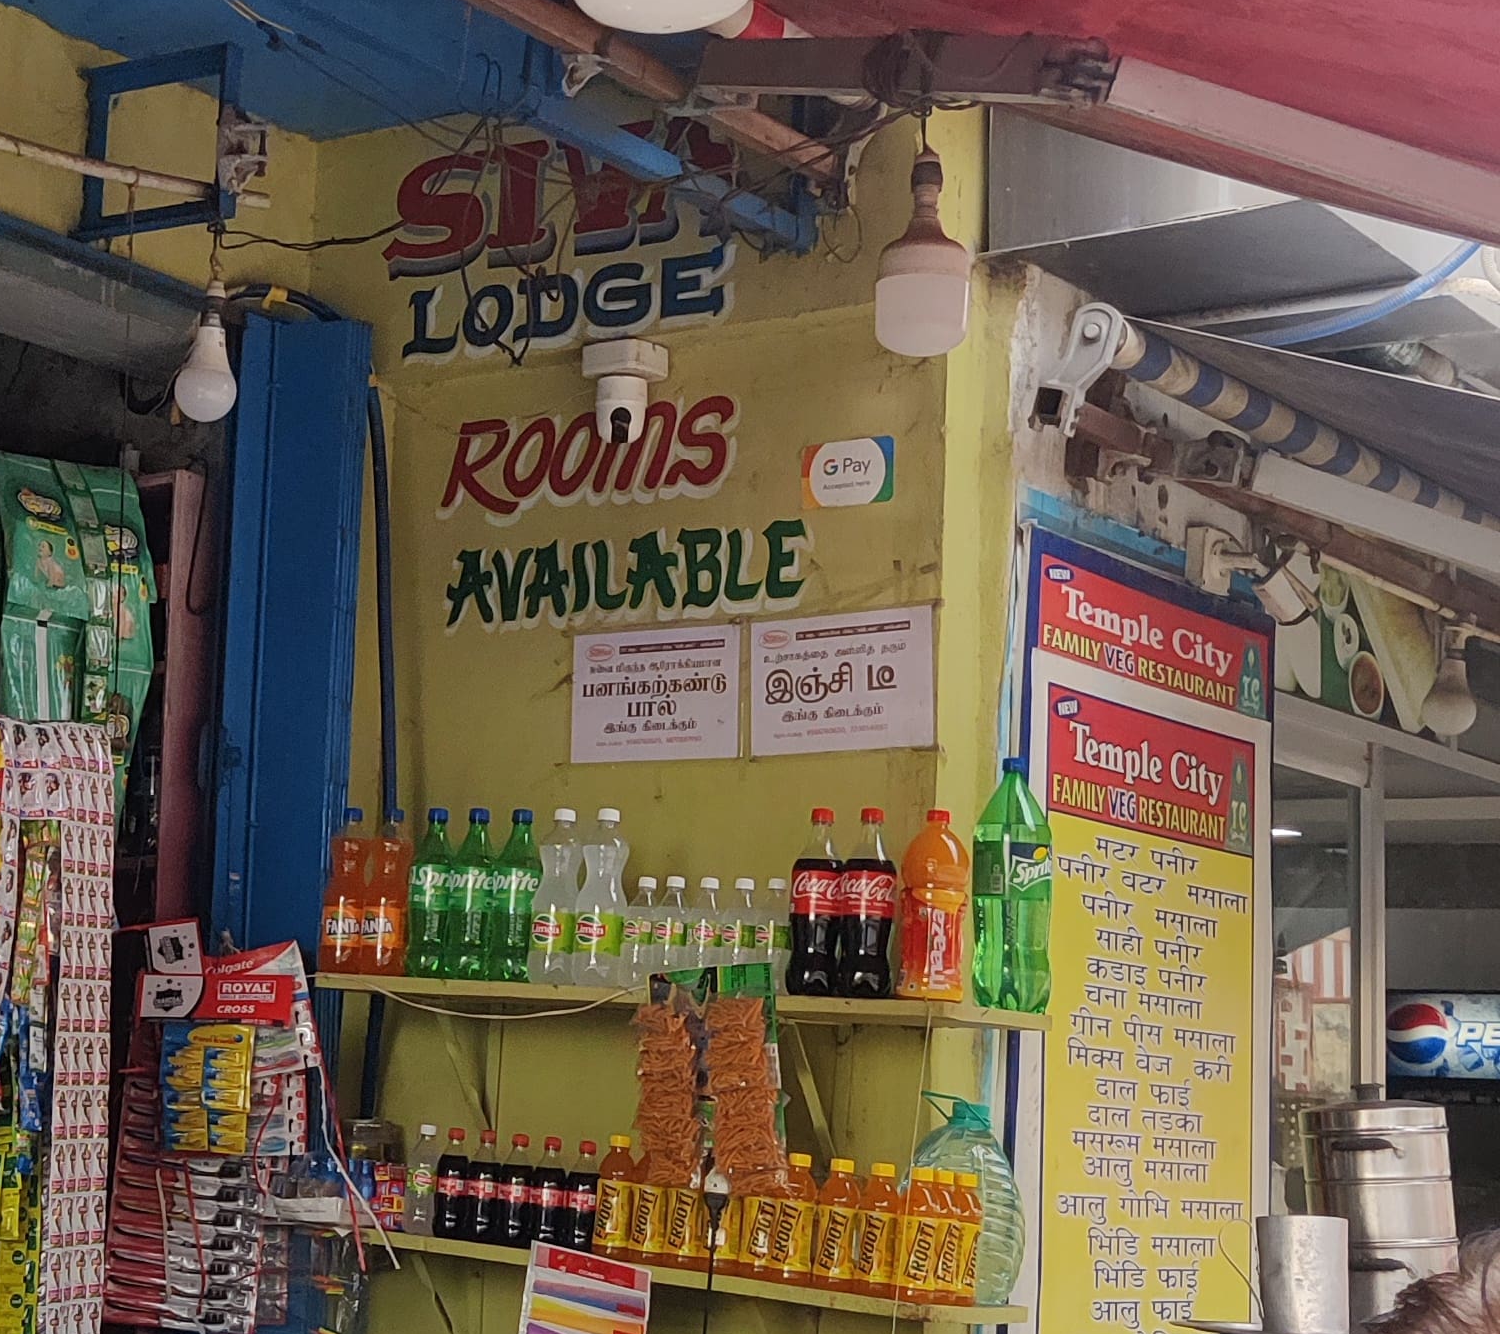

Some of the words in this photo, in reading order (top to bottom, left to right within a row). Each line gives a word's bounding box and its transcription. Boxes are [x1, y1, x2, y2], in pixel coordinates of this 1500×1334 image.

[402, 248, 730, 360] LODGE
[440, 395, 737, 517] ROOMS
[842, 457, 871, 476] Pay
[445, 519, 808, 629] AVAILABLE
[1060, 583, 1164, 651] Temple
[1172, 627, 1233, 677] City
[765, 661, 853, 705] இஞ்சி
[1042, 624, 1102, 663] FAMILY
[1102, 642, 1136, 676] VEG
[1137, 656, 1238, 708] RESTAURANT
[627, 693, 677, 717] பால்
[1069, 719, 1163, 785] Temple
[1170, 752, 1224, 807] City
[1052, 774, 1107, 813] FAMILY
[1107, 787, 1136, 823] VEG
[1138, 795, 1227, 844] RESTAURANT
[1096, 838, 1139, 861] मटर
[1151, 848, 1198, 875] पनीर
[1058, 854, 1109, 886] पनीर
[1188, 885, 1247, 913] मसाला
[1083, 892, 1133, 921] पनीर
[1156, 910, 1217, 937] मसाला
[1156, 937, 1202, 964] पनीर
[221, 982, 272, 994] ROYAL
[1159, 966, 1206, 994] पनीर
[216, 1004, 256, 1014] CROSS
[1085, 985, 1126, 1009] चना
[1139, 993, 1201, 1018] मसाला
[1124, 1016, 1162, 1044] पीस
[1175, 1028, 1235, 1053] मसाला
[1068, 1037, 1123, 1070] मिक्स
[1136, 1045, 1171, 1075] वेज
[1194, 1056, 1231, 1082] करी
[1097, 1079, 1137, 1101] दाल
[1089, 1106, 1130, 1127] दाल
[1153, 1137, 1216, 1159] मसाला
[1145, 1161, 1208, 1181] मसाला
[632, 1187, 659, 1245] FROOTI
[668, 1190, 697, 1250] FROOTI
[1182, 1201, 1242, 1219] मसाला
[818, 1209, 848, 1272] FROOTI
[906, 1220, 937, 1284] FROOTI
[1152, 1237, 1215, 1256] मसाला
